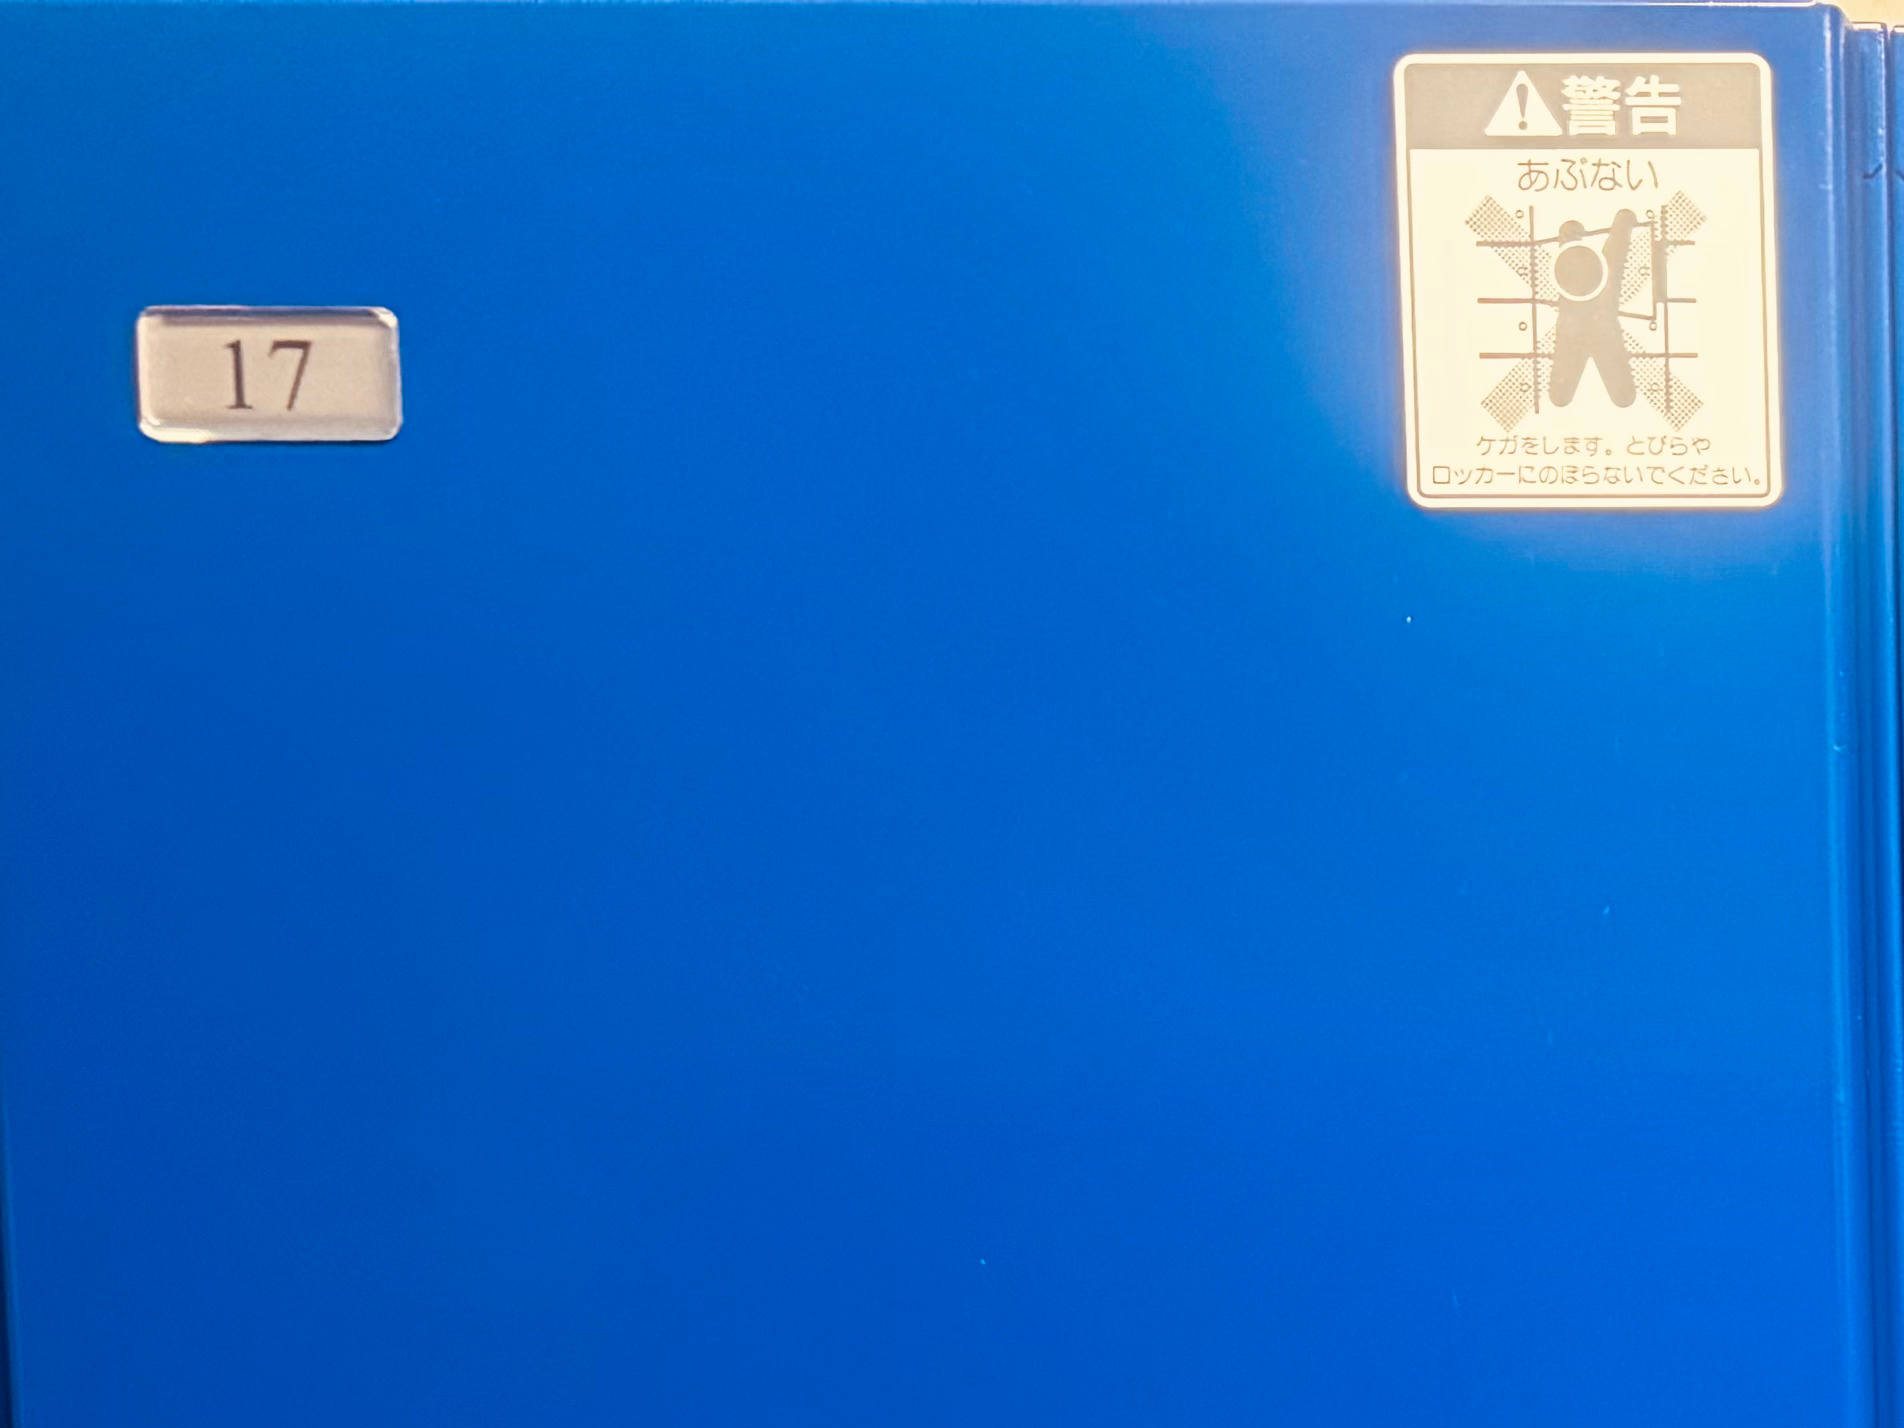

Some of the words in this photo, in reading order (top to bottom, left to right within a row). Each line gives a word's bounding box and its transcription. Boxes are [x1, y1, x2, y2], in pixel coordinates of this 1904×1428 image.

[1562, 75, 1682, 136] 警告
[1517, 158, 1660, 192] あぶない
[223, 339, 312, 411] 17
